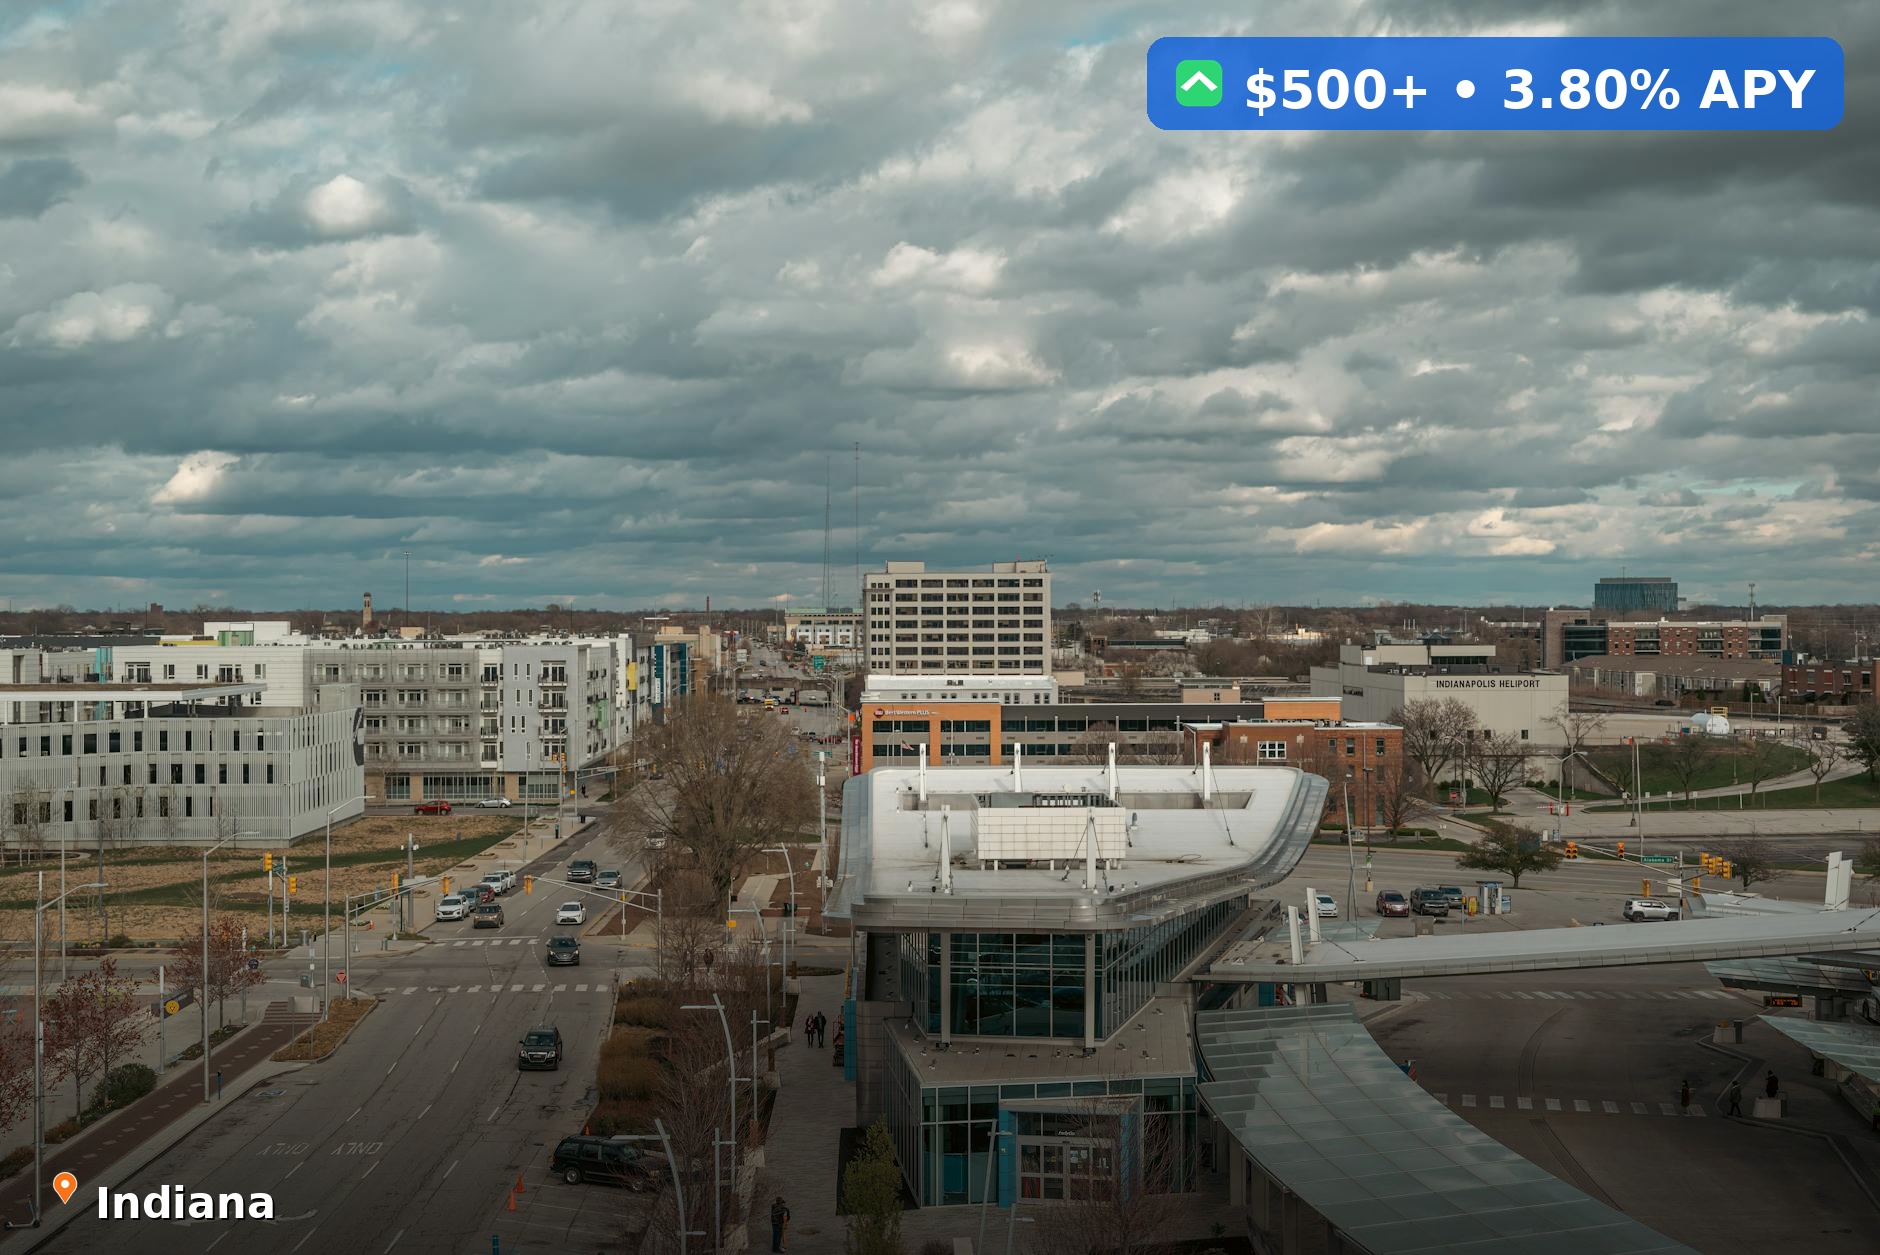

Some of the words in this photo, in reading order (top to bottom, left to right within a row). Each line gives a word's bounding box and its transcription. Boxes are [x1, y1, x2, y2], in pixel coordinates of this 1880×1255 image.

[1436, 679, 1496, 688] INDIANAPOLIS
[1499, 679, 1540, 688] HELIPORT
[256, 1142, 310, 1156] ONLY
[330, 1142, 383, 1156] ONLY
